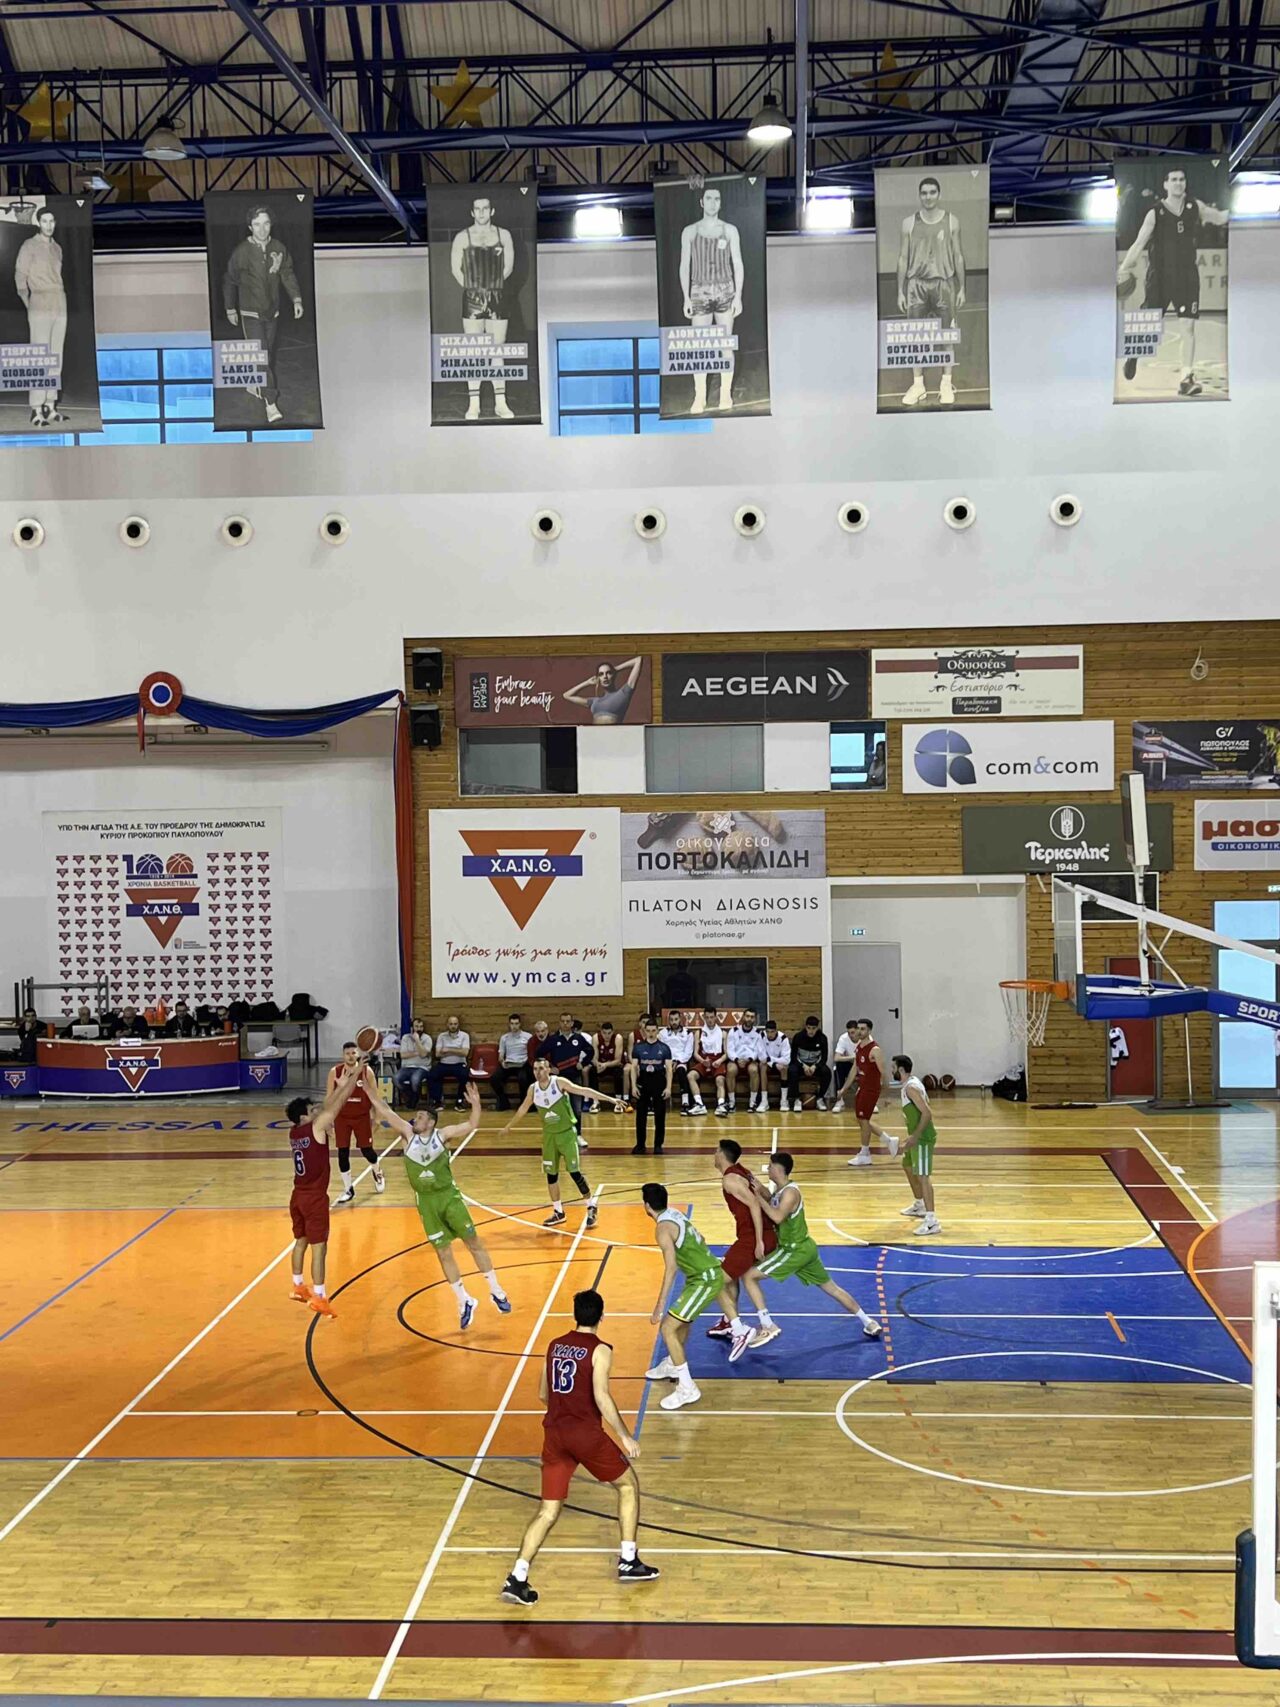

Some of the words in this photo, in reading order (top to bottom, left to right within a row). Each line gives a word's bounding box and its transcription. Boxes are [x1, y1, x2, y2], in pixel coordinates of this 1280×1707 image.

[1124, 334, 1159, 344] NIKOS
[440, 345, 525, 357] ΓΙΑΝΝΟΥΖΑΚΟΣ
[886, 344, 931, 354] SOTIRIS
[1124, 345, 1154, 355] ZISIS
[668, 350, 716, 361] DIONISIS
[887, 354, 951, 366] NIKOLAIDIS
[440, 358, 486, 368] MIHALIS
[669, 361, 731, 372] ANANIADIS
[2, 367, 45, 378] GIORGOS
[221, 364, 254, 374] LAKIS
[440, 368, 525, 379] GIANNOUZAKOS
[2, 378, 57, 388] TRONTZOS
[222, 375, 264, 385] TSAVAS
[947, 659, 1007, 670] Οδυσσέας
[494, 675, 536, 694] Embrace
[681, 675, 817, 696] AEGEAN
[473, 685, 481, 708] DUST
[479, 677, 488, 708] CREAM
[494, 694, 519, 713] your
[520, 690, 555, 712] beauty
[986, 756, 1099, 775] com&com
[90, 823, 114, 831] ΑΙΓΙΔΑ
[115, 823, 129, 831] ΤΗΣ
[160, 822, 198, 830] ΠΡΟΕΔΡΟΥ
[215, 821, 265, 829] ΔΗΜΟΚΡΑΤΙΑΣ
[100, 832, 126, 840] ΚΥΡΙΟΥ
[128, 831, 170, 839] ΠΡΟΚΟΠΙΟΥ
[171, 830, 224, 838] ΠΑΥΛΟΠΟΥΛΟΥ
[491, 858, 556, 873] Χ.Α.Ν.Θ.
[637, 849, 809, 871] ΠΟΡΤΟΚΑΛΙΔΗ
[1056, 863, 1080, 872] 1948
[446, 971, 608, 987] www.ymca.gr
[552, 1357, 577, 1394] 13
